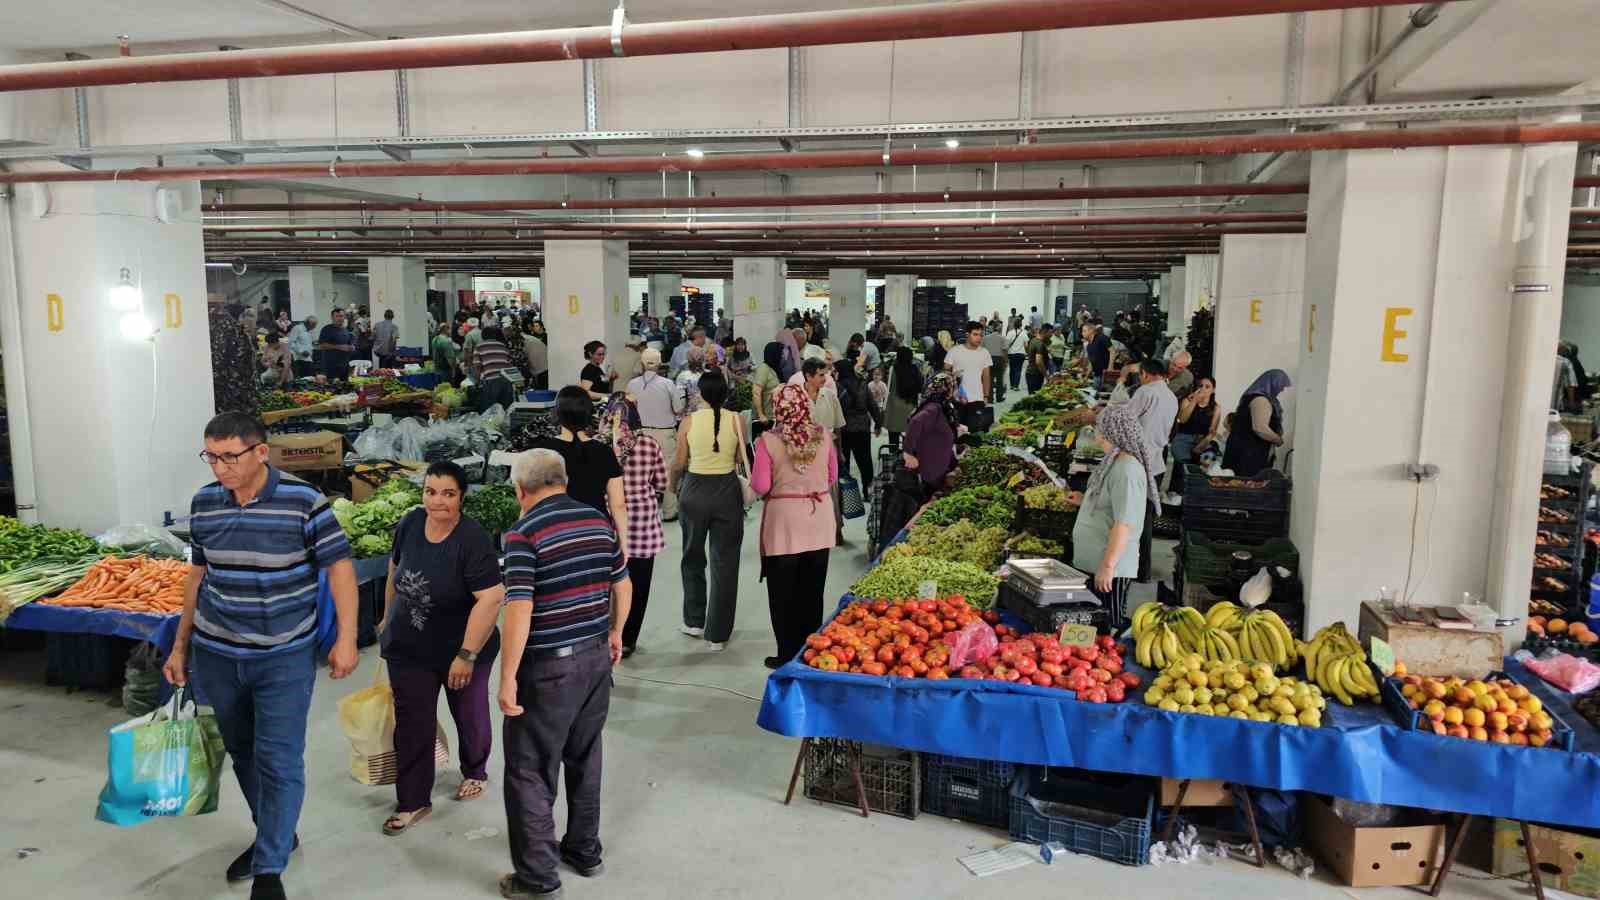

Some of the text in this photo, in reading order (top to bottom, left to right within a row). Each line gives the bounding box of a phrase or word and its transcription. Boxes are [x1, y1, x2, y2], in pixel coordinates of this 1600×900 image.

[48, 293, 64, 333] D
[164, 293, 183, 329] D
[568, 295, 580, 315] D
[1250, 299, 1263, 324] E
[1380, 307, 1414, 362] E
